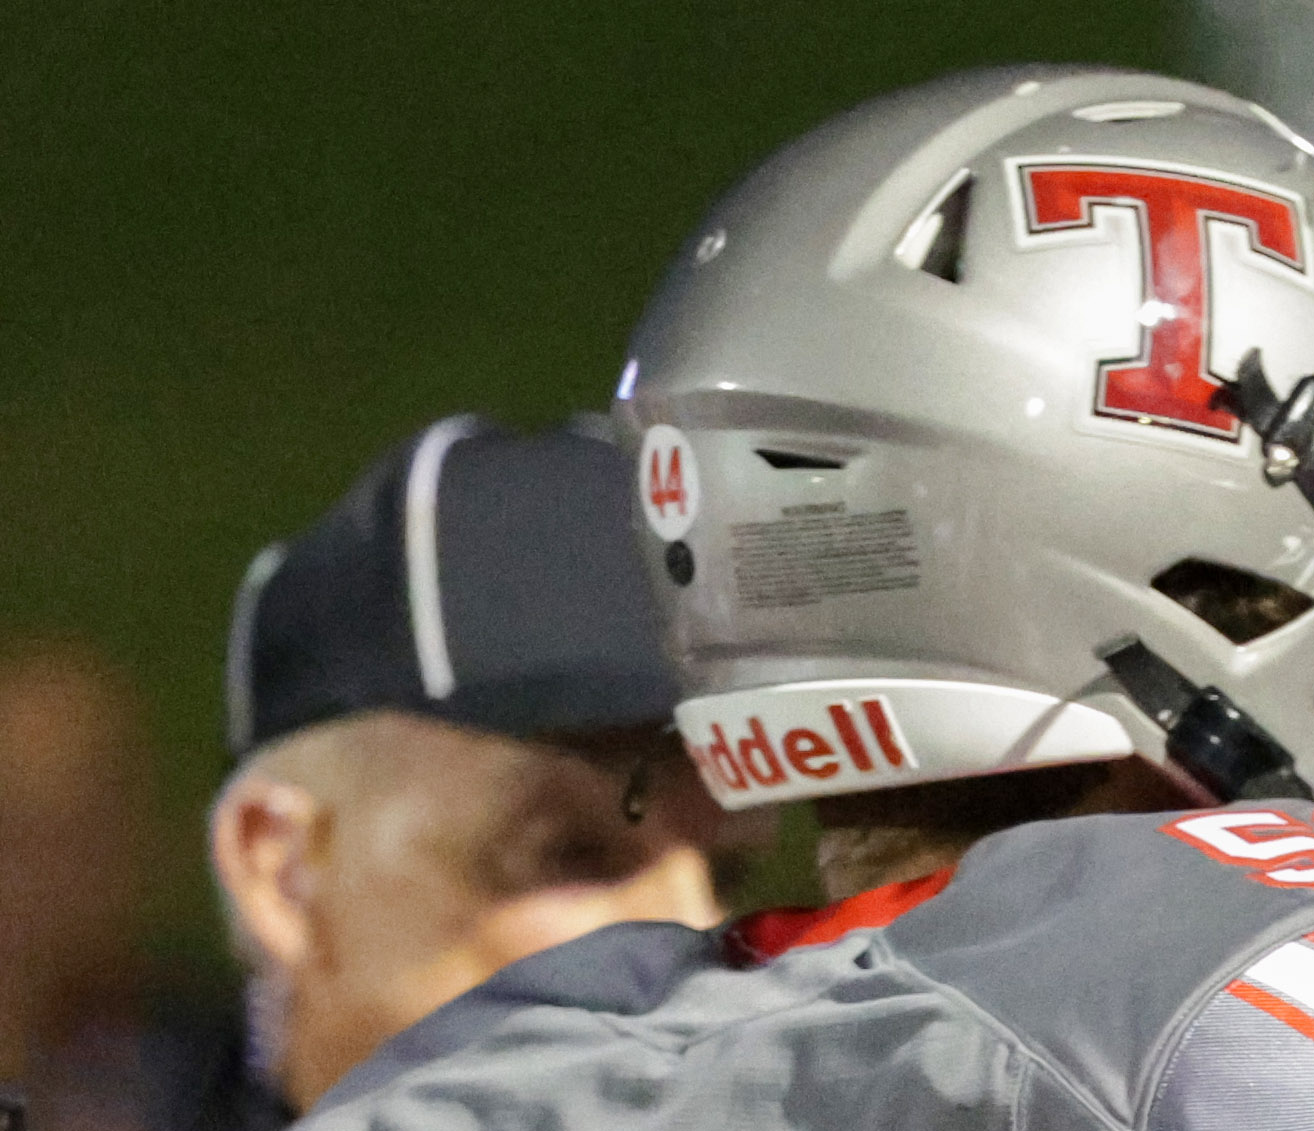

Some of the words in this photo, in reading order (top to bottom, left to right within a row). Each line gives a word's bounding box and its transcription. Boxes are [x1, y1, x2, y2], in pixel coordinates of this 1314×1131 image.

[1016, 162, 1307, 444] T
[651, 446, 689, 518] 44
[688, 698, 905, 791] ddell
